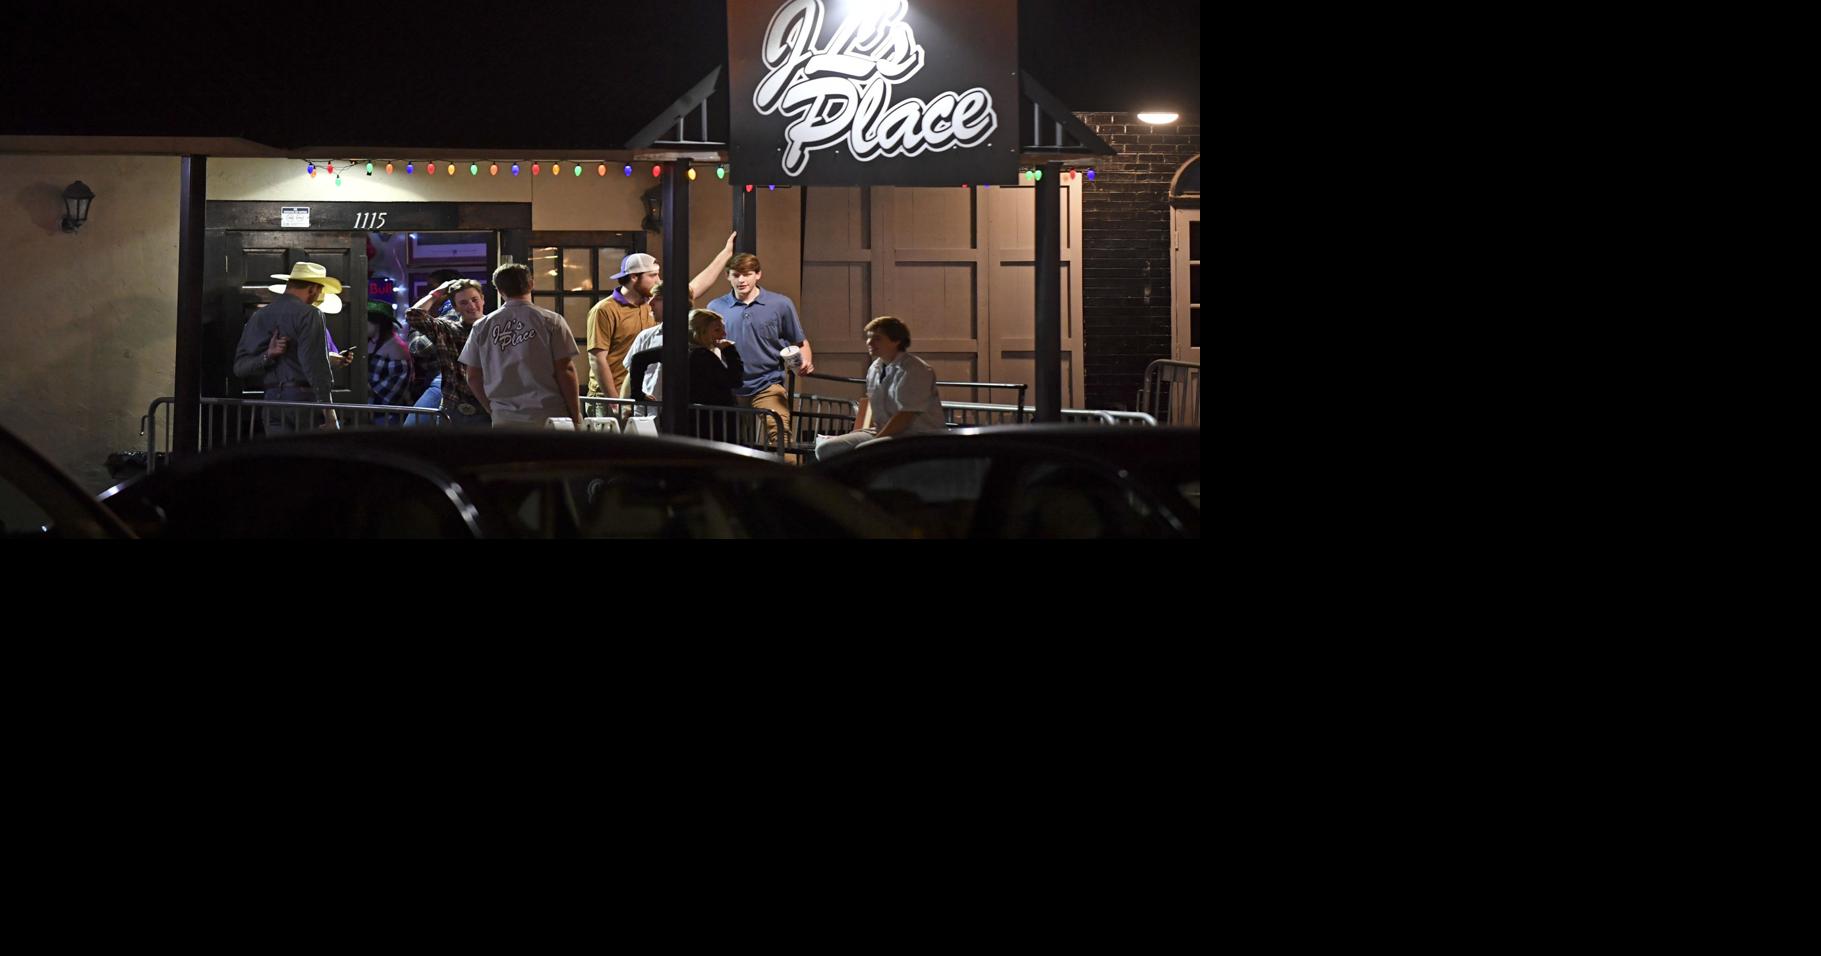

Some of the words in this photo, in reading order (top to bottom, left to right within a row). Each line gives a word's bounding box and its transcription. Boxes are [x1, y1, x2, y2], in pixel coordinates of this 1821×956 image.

[780, 77, 998, 177] Place
[353, 212, 387, 229] 1115
[499, 328, 536, 351] Place
